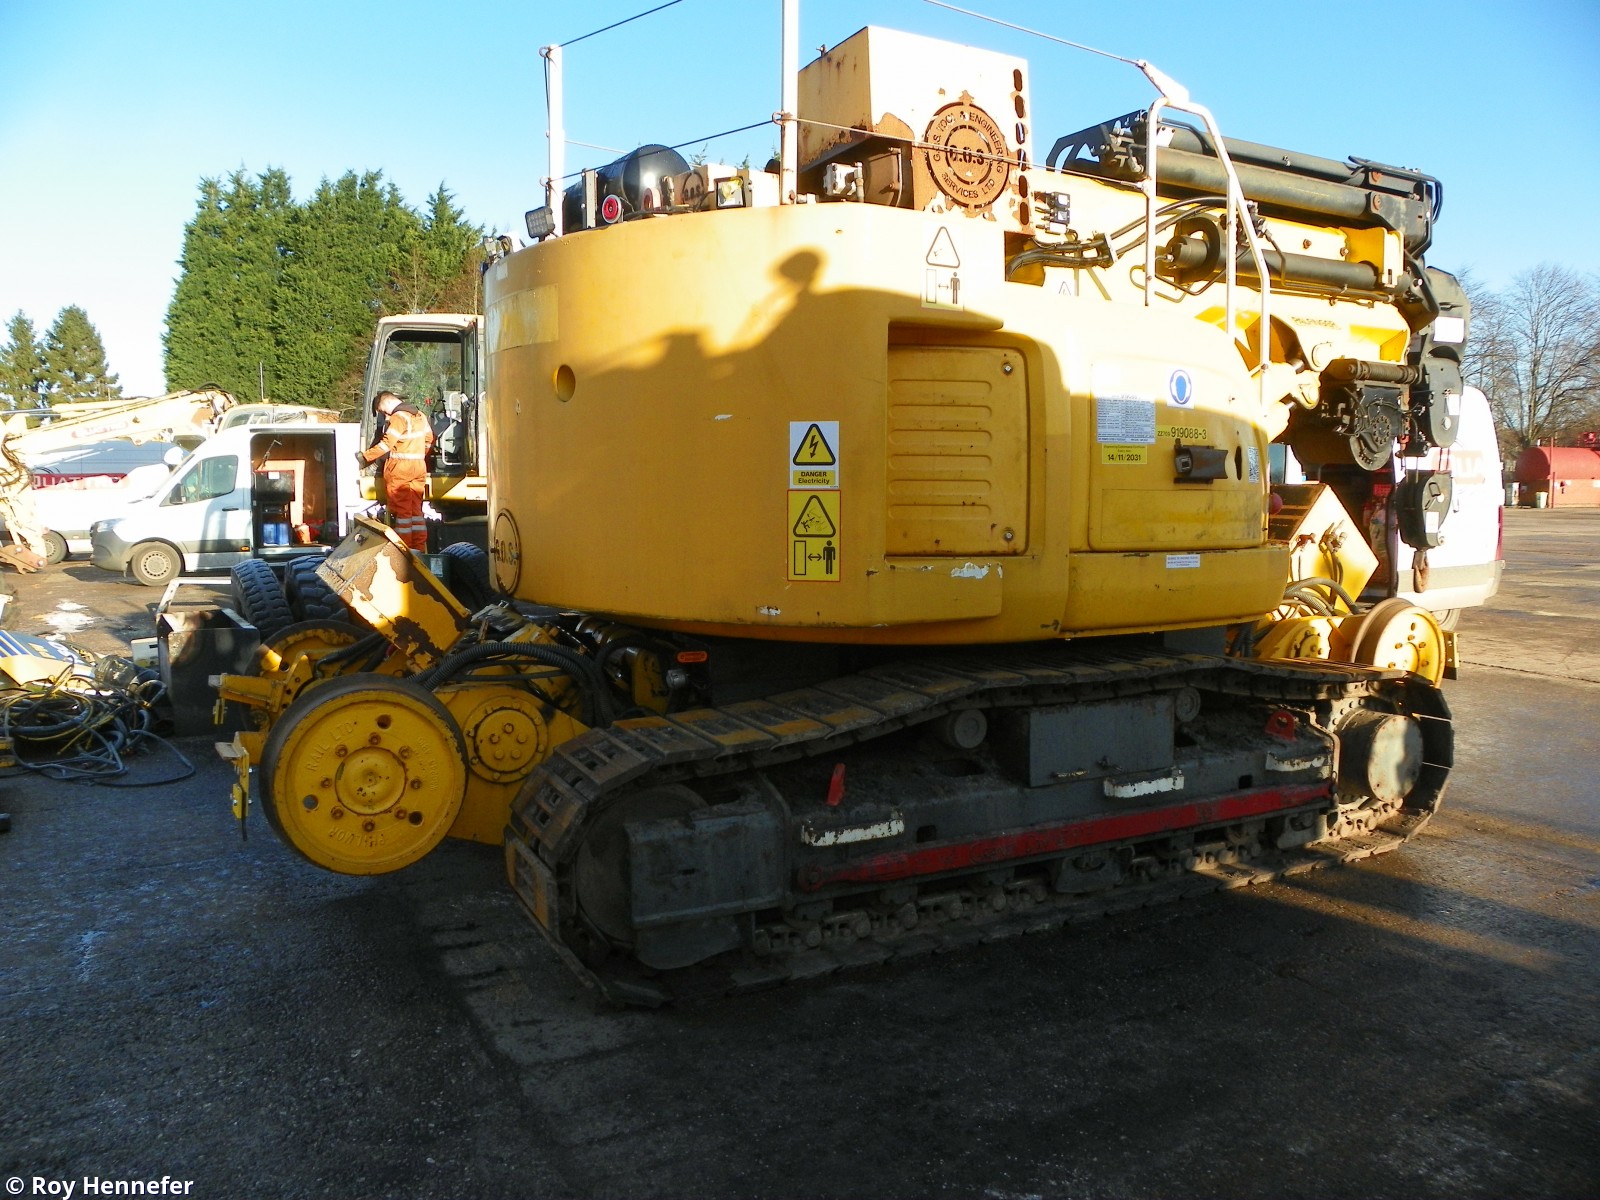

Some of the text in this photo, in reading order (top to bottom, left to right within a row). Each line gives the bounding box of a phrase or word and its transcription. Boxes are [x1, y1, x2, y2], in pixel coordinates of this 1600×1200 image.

[969, 112, 1004, 173] ENGINEERNG
[941, 172, 996, 198] SERVICES LTD
[1170, 426, 1207, 440] 919088-3
